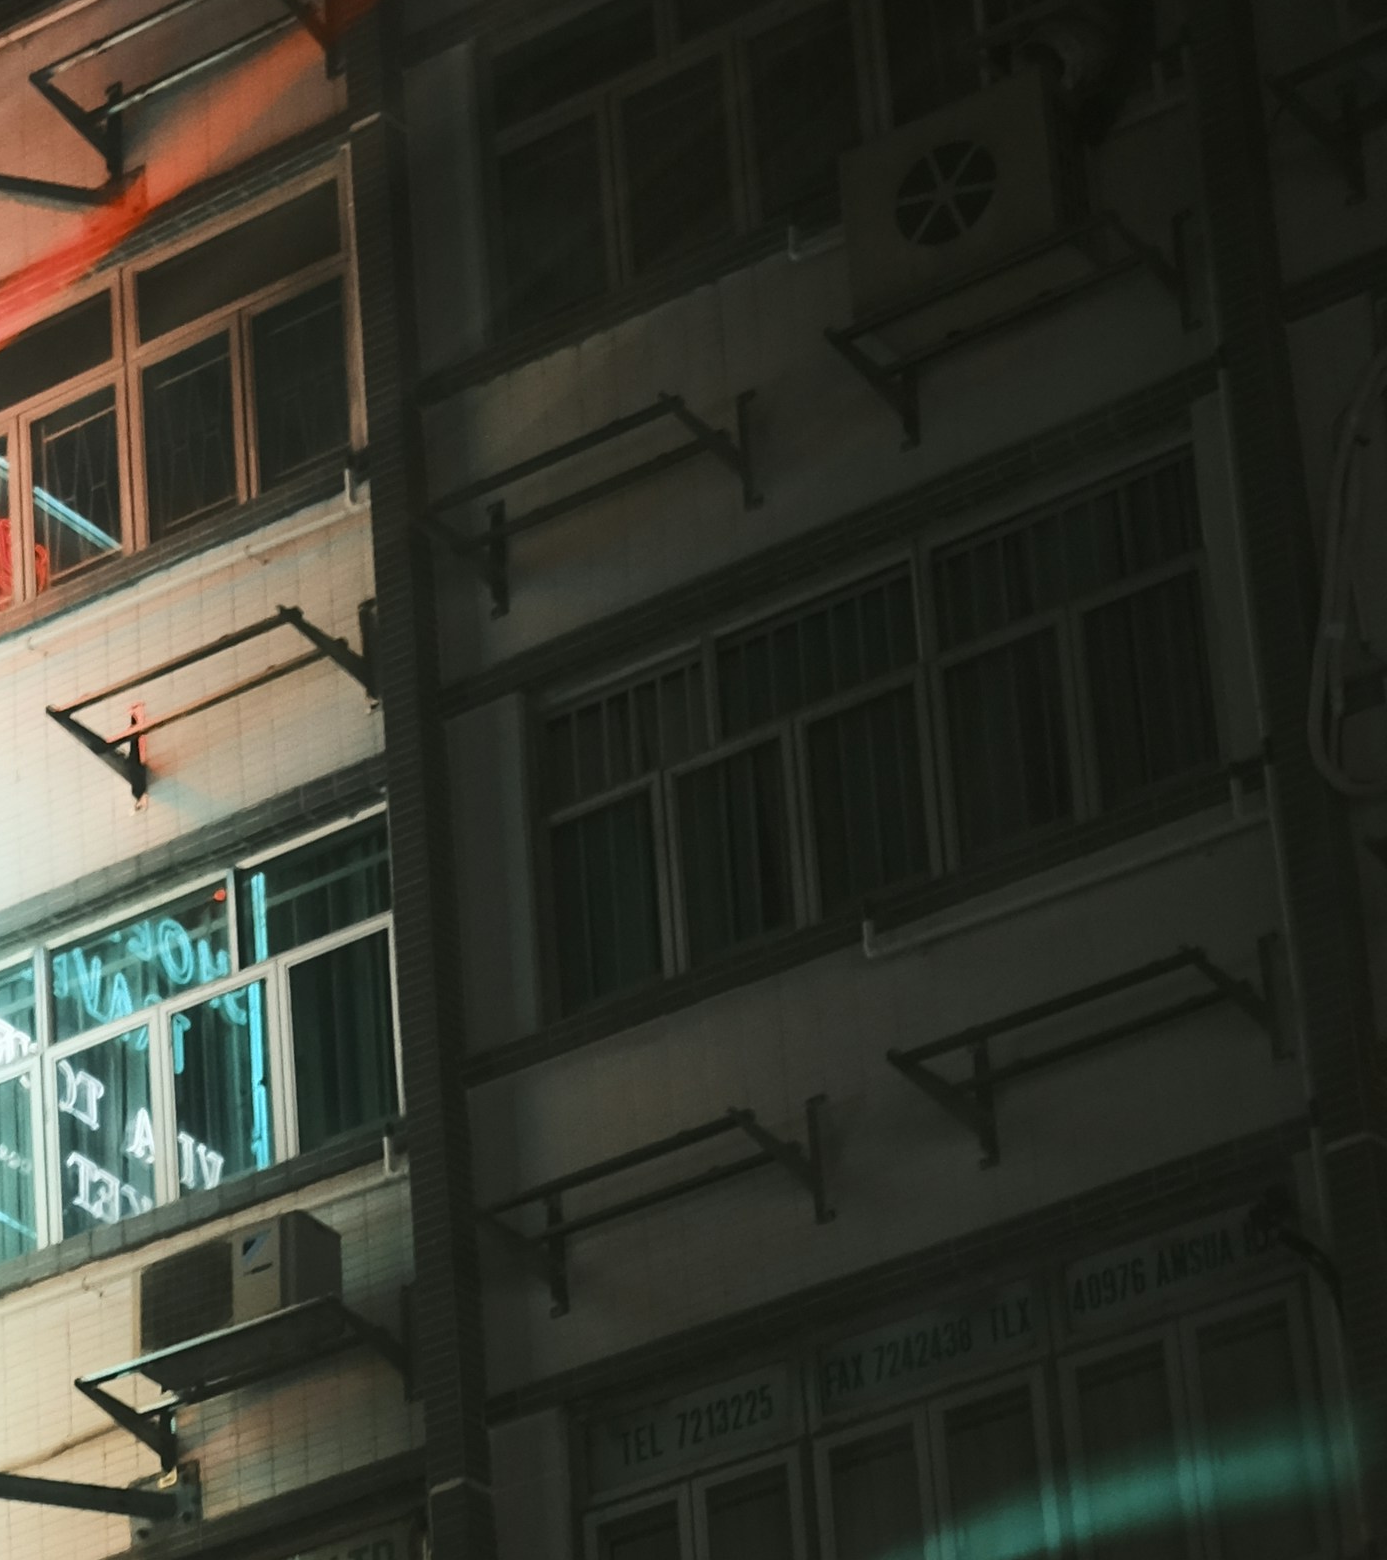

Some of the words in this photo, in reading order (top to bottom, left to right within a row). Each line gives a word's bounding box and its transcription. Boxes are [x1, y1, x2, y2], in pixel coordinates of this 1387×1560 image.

[621, 1421, 664, 1467] TEL
[676, 1383, 774, 1450] 7213225
[823, 1352, 866, 1399] FAX
[872, 1315, 974, 1384] 7242438
[988, 1296, 1033, 1344] TLX
[1071, 1256, 1145, 1314] 40976
